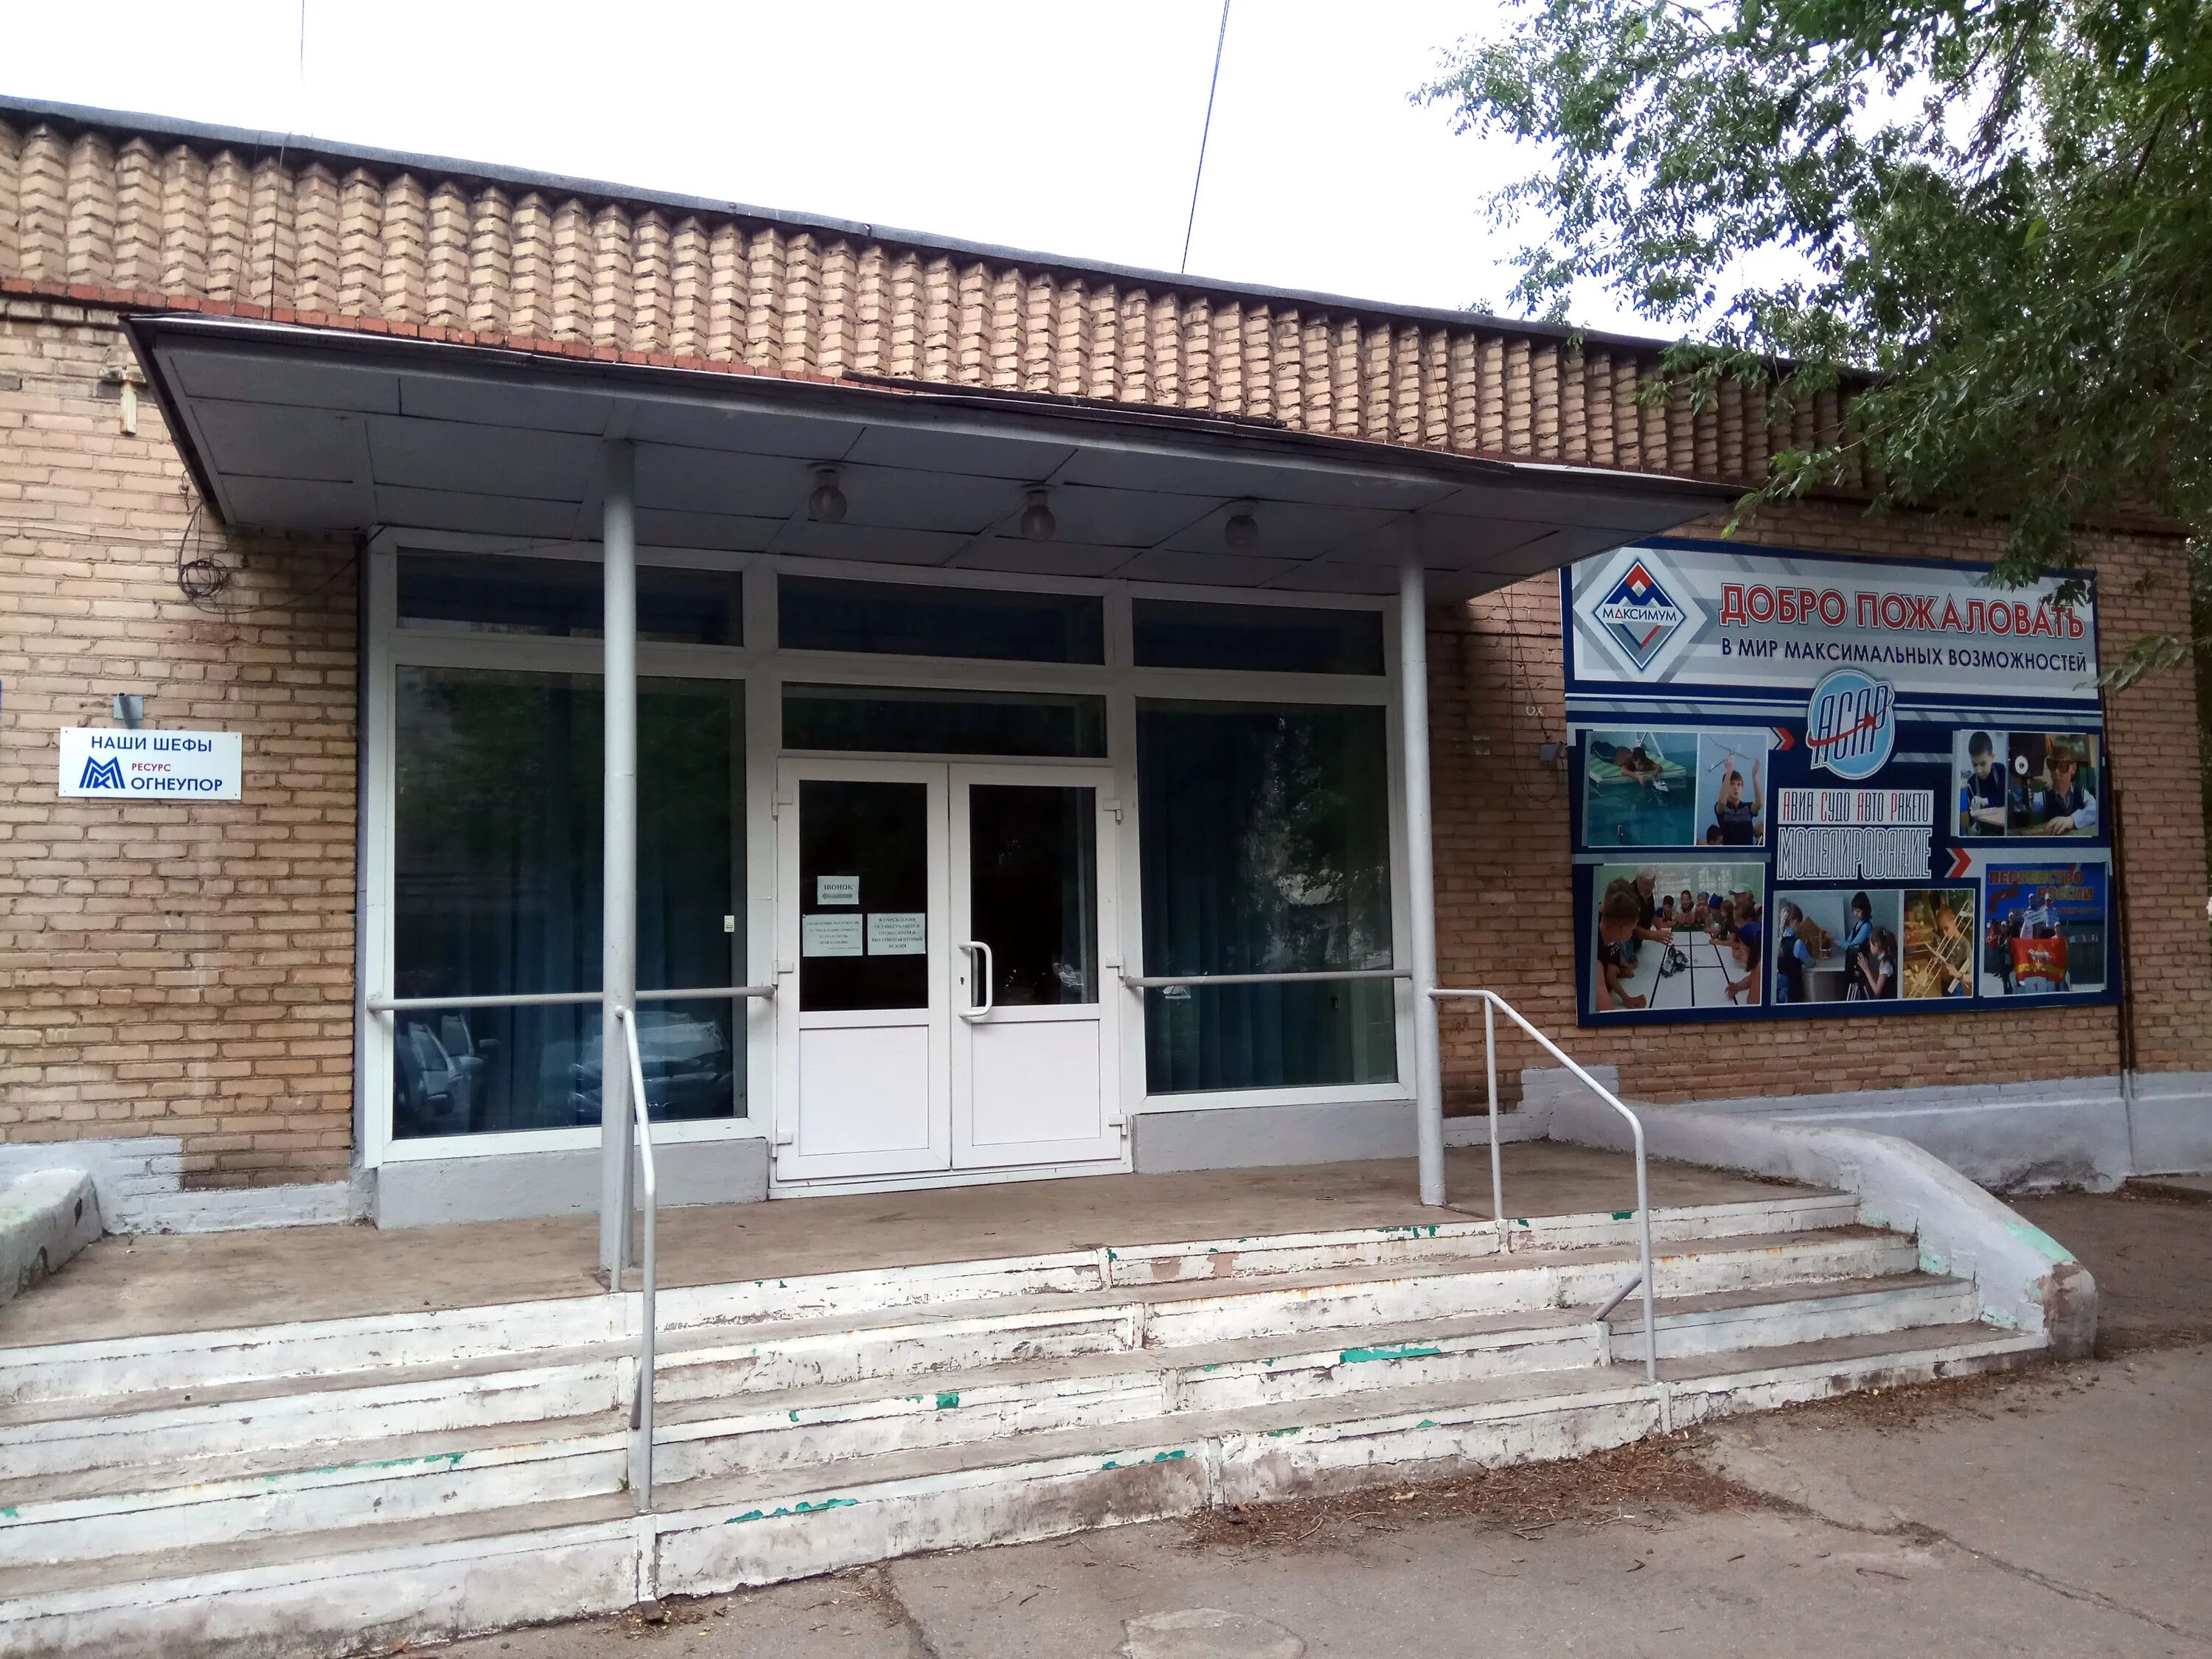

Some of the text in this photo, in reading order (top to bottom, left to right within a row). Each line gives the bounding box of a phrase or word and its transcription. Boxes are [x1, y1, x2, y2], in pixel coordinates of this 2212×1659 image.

[1602, 608, 1677, 622] МАКСИМУМ
[1719, 582, 2085, 640] ДОБРО ПОЖАЛОВАТЬ
[1722, 637, 2087, 672] В МИР МАКСИМАЛЬНЫХ ВОЗМОЖНОСТЕЙ
[91, 736, 212, 752] НАШИ ШЕФЫ
[131, 762, 171, 772] РЕСУРС
[131, 777, 223, 791] ОГНЕУПОР
[1777, 827, 1933, 880] МОДЕЛИРОВАНИЕ
